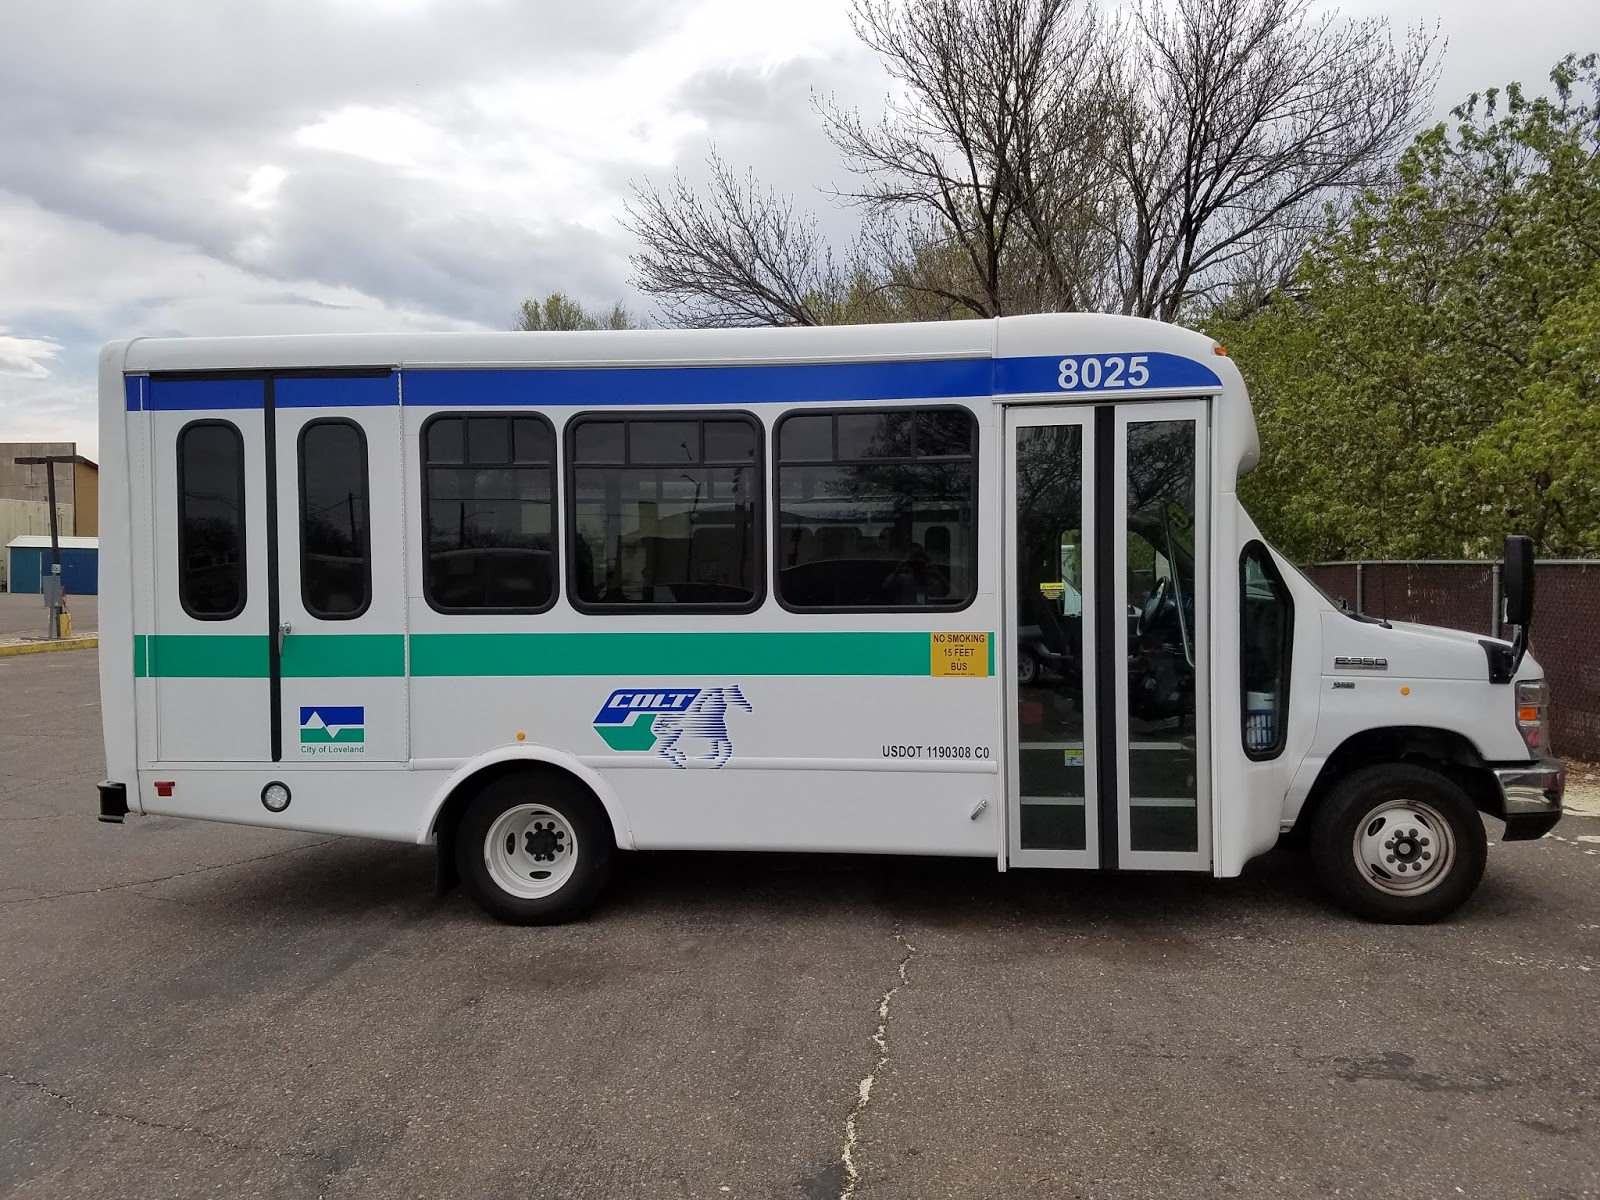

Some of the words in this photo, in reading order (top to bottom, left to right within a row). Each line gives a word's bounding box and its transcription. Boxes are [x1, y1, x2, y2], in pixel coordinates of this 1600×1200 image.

[1058, 356, 1150, 389] 8025
[933, 634, 946, 643] NO
[947, 634, 985, 643] SMOKING
[943, 648, 953, 657] 15
[954, 648, 975, 657] FEET
[950, 662, 968, 671] BUS
[607, 693, 696, 709] COLT
[300, 745, 317, 755] City
[318, 745, 327, 753] of
[328, 745, 365, 753] Loveland
[882, 745, 923, 758] USDOT
[926, 746, 971, 759] 1190308
